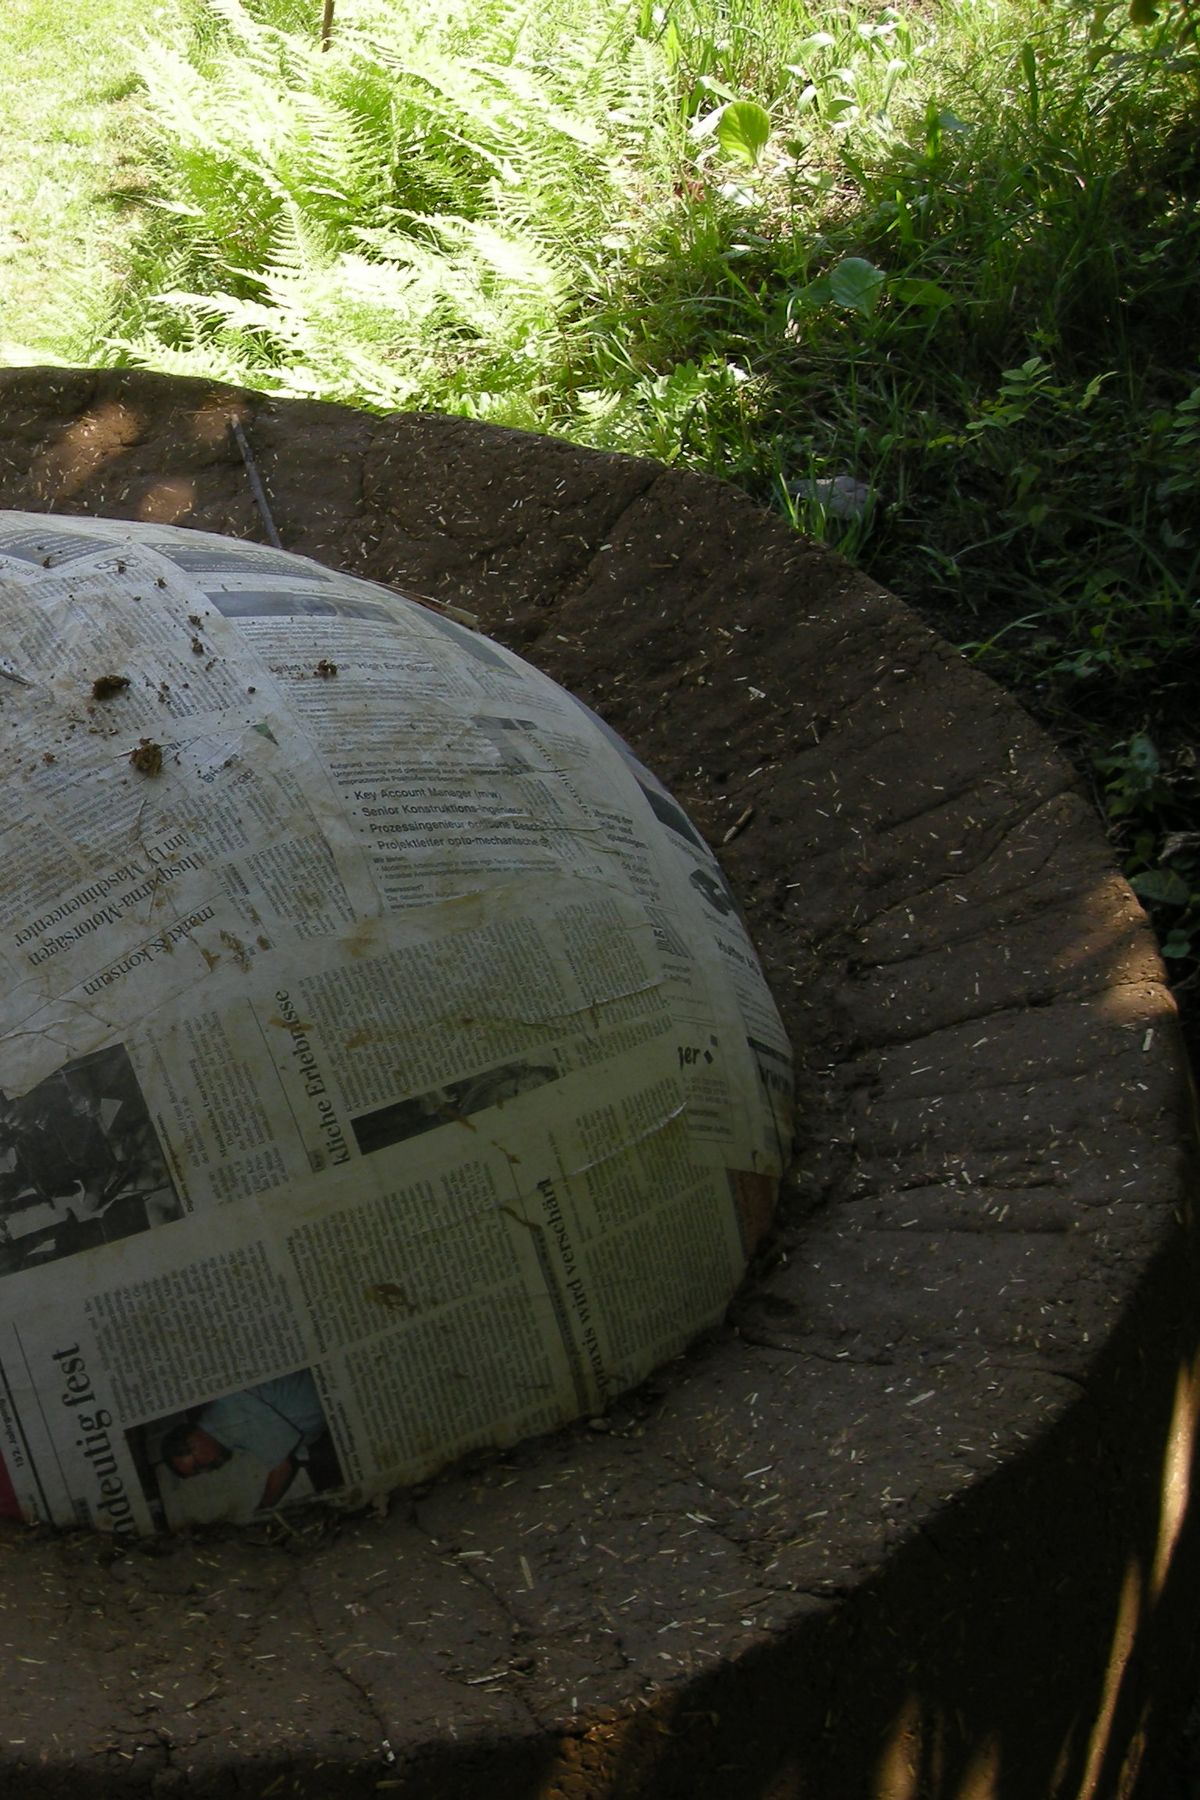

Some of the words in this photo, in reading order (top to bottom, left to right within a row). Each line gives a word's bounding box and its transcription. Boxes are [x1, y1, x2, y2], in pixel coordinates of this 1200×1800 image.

[354, 790, 376, 801] Key
[380, 788, 424, 800] Account
[428, 788, 472, 799] Manager
[361, 804, 399, 817] Senior
[369, 820, 464, 833] Prozessingenieur
[163, 831, 189, 856] im
[377, 837, 444, 851] Projektleiter
[10, 858, 144, 951] Maschinencenter
[24, 846, 204, 972] Husqvarna-Motorsägen
[165, 904, 217, 945] markt
[148, 936, 169, 956] &
[81, 947, 152, 1000] konsum
[314, 1098, 351, 1165] kliche
[564, 1276, 594, 1324] wird
[47, 1341, 96, 1407] fest
[9, 1445, 25, 1468] 152.
